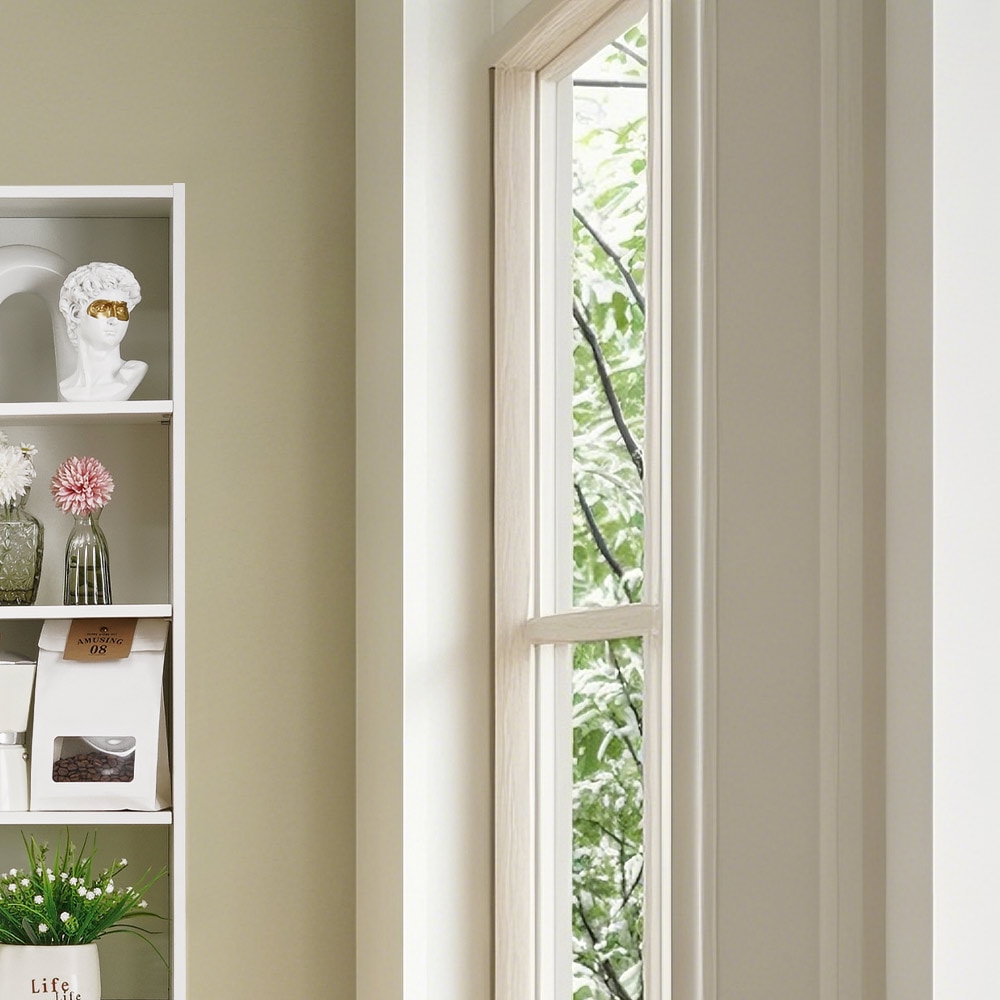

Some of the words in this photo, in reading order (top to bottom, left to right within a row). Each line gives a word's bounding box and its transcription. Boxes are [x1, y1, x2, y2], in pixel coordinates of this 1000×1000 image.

[77, 637, 124, 645] AMUSING
[90, 644, 107, 654] 08
[31, 977, 70, 994] Life
